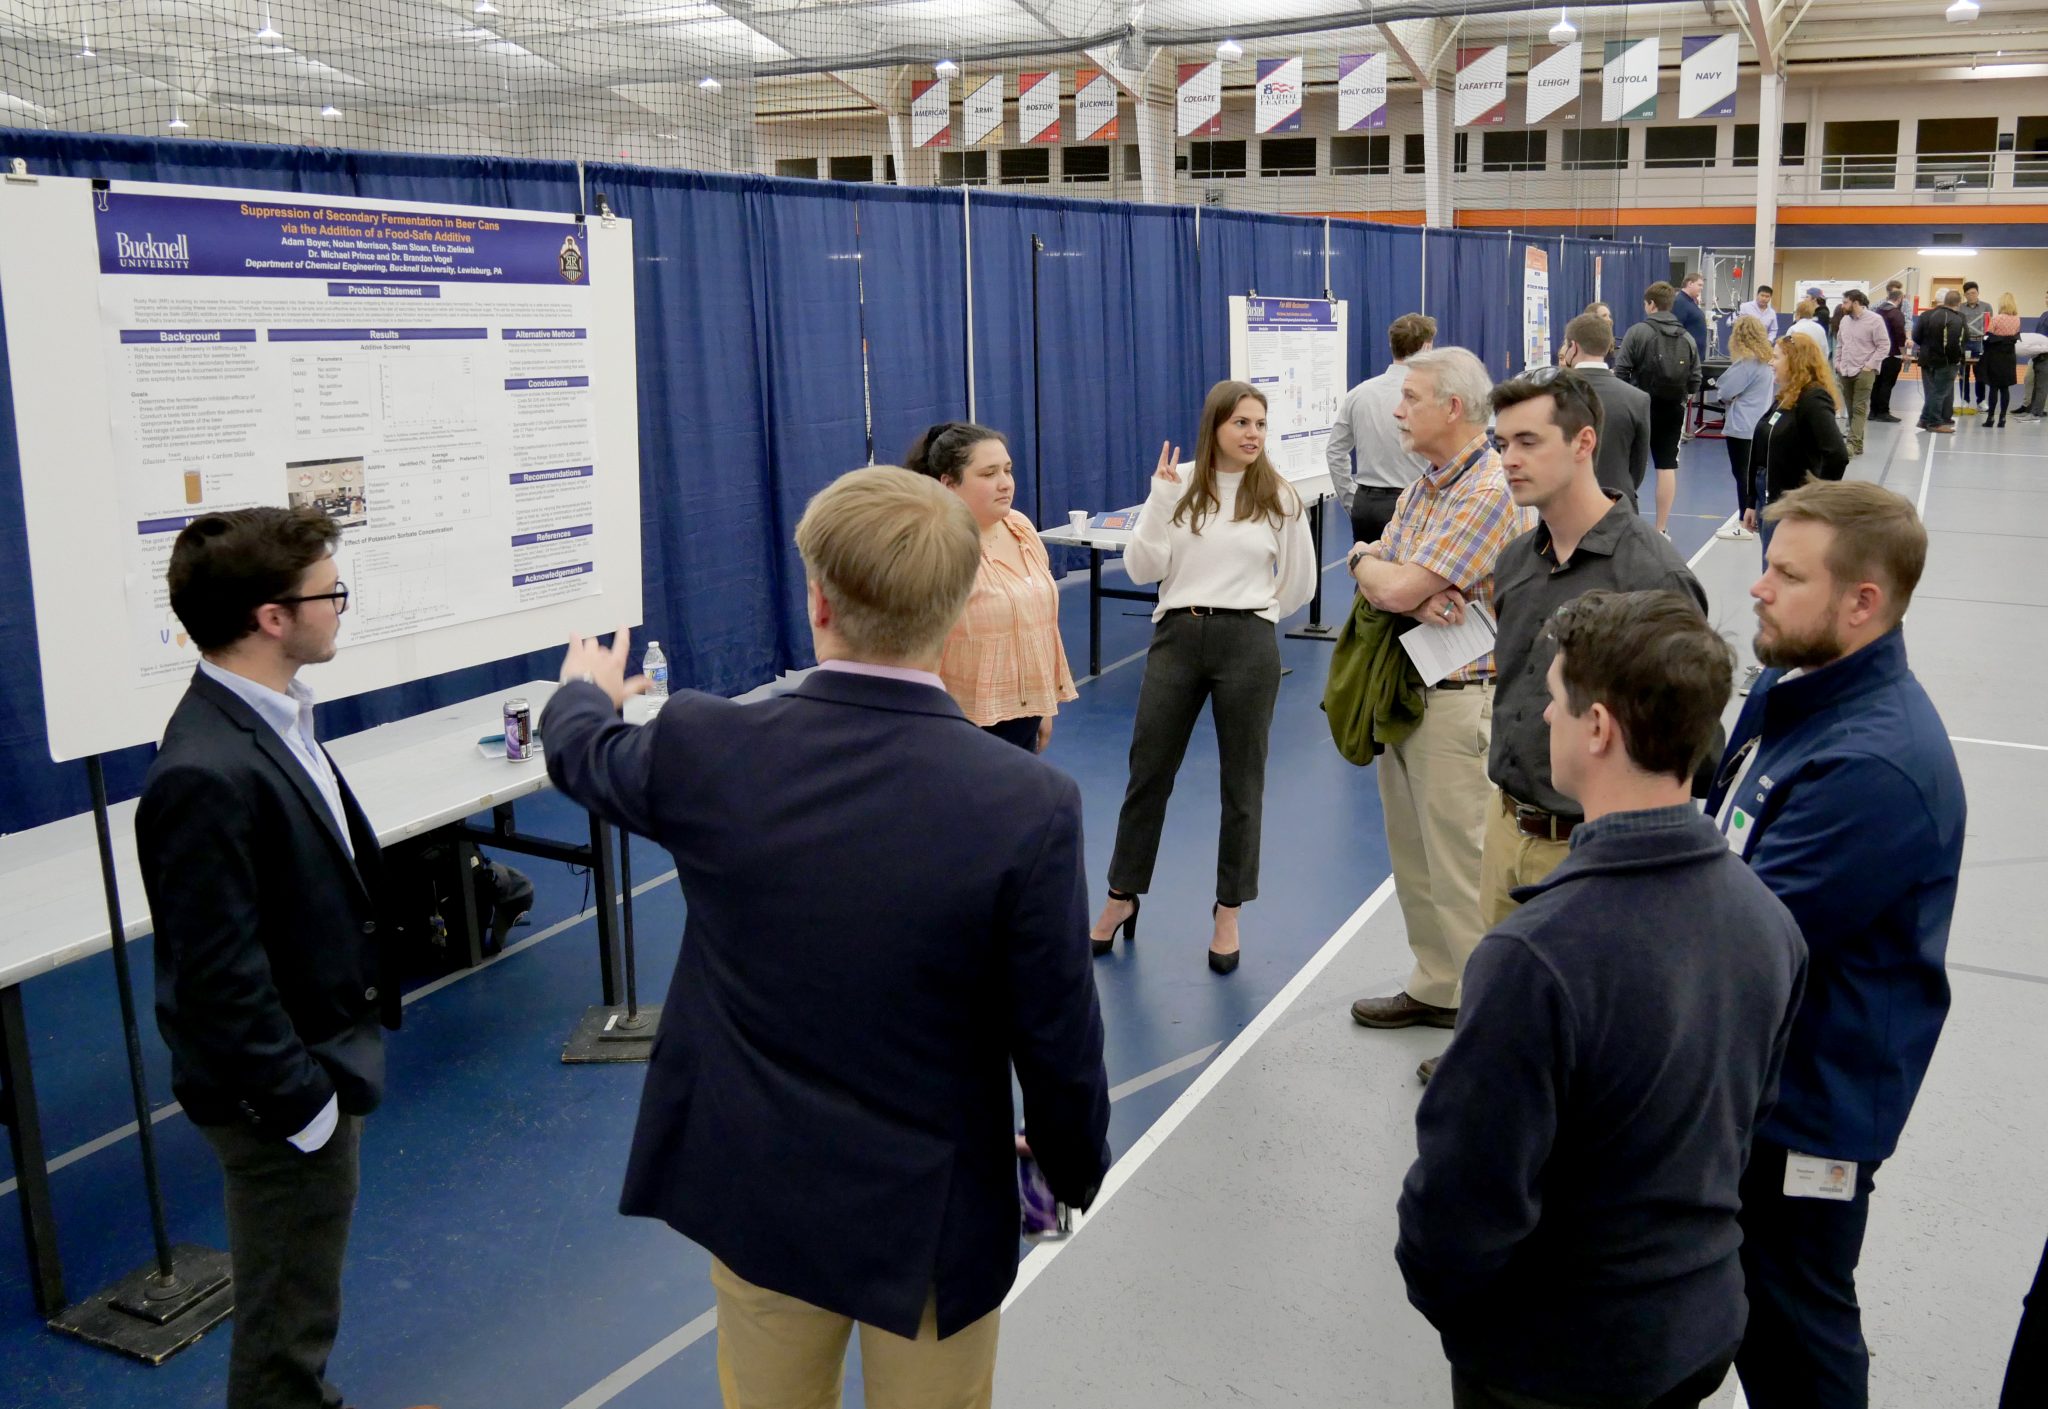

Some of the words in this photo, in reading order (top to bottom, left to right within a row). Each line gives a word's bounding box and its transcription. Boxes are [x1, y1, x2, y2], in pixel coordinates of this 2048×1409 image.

[1612, 75, 1648, 84] LOYOLA
[1696, 72, 1722, 80] NAVY
[1458, 82, 1504, 90] LAFAYETTE
[1538, 78, 1570, 87] LEHIGH
[1340, 88, 1360, 96] HOLY
[1362, 86, 1384, 94] CROSS
[1184, 94, 1216, 103] COLGATE
[1080, 100, 1114, 108] BUCKNELL
[914, 109, 948, 117] AMERICAN
[974, 106, 994, 114] ARMY
[240, 204, 310, 219] Suppression
[313, 208, 324, 220] of
[326, 210, 379, 225] Secondary
[382, 213, 442, 228] Fermentation
[445, 218, 454, 228] in
[456, 218, 475, 230] Beer
[478, 220, 500, 231] Cans
[281, 223, 298, 234] via
[300, 224, 317, 235] the
[320, 224, 362, 236] Addition
[364, 227, 374, 238] of
[377, 230, 383, 238] a
[385, 228, 432, 240] Food-Safe
[434, 231, 471, 242] Additive
[115, 232, 190, 260] Bucknell
[281, 237, 304, 246] Adam
[306, 238, 331, 249] Boyer,
[332, 239, 355, 248] Nolan
[356, 240, 390, 251] Morrison,
[392, 242, 408, 251] Sam
[410, 243, 430, 253] Sloan,
[432, 244, 446, 252] Erin
[447, 245, 474, 254] Zielinski
[308, 250, 320, 258] Dr.
[321, 250, 350, 259] Michael
[352, 251, 375, 260] Prince
[377, 253, 390, 261] and
[392, 254, 402, 262] Dr.
[404, 254, 432, 262] Brandon
[434, 255, 452, 265] Vogel
[120, 259, 190, 268] UNIVERSITY
[246, 258, 293, 270] Department
[295, 260, 304, 269] of
[305, 260, 340, 270] Chemical
[342, 262, 388, 274] Engineering,
[390, 264, 420, 272] Bucknell
[421, 264, 456, 276] University,
[458, 266, 492, 276] Lewisburg,
[494, 267, 503, 276] PA
[348, 285, 382, 295] Problem
[383, 286, 422, 296] Statement
[160, 332, 220, 342] Background
[370, 330, 400, 339] Results
[516, 330, 550, 338] Alternative
[552, 330, 576, 338] Method
[528, 379, 568, 388] Conclusions
[523, 469, 582, 482] Recommendations
[368, 533, 396, 544] Potassium
[418, 526, 454, 536] Concentration
[536, 530, 572, 542] References
[524, 566, 584, 583] Acknowledgements
